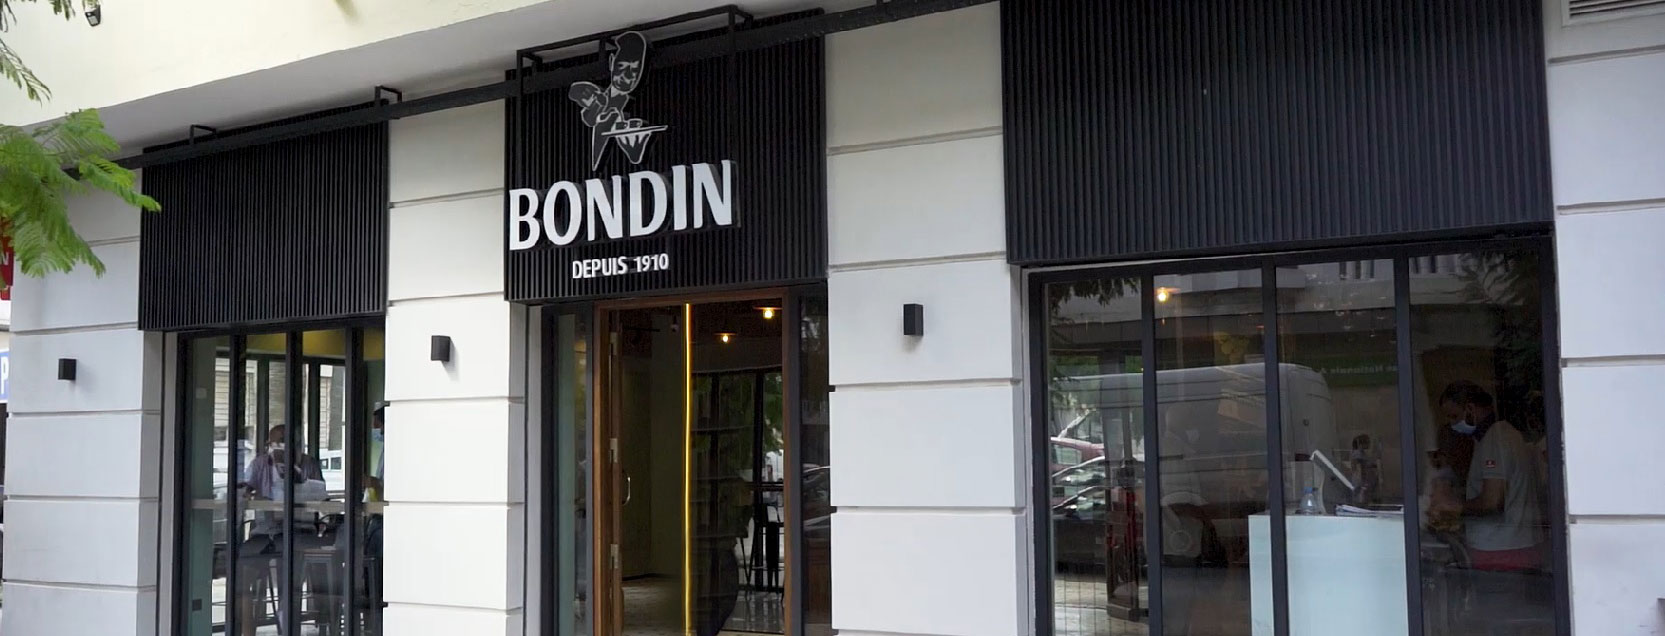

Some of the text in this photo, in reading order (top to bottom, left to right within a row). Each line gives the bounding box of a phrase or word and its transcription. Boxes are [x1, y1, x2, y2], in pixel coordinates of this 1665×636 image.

[509, 159, 733, 251] BONDIN
[572, 252, 669, 279] DEPUIS 1910
